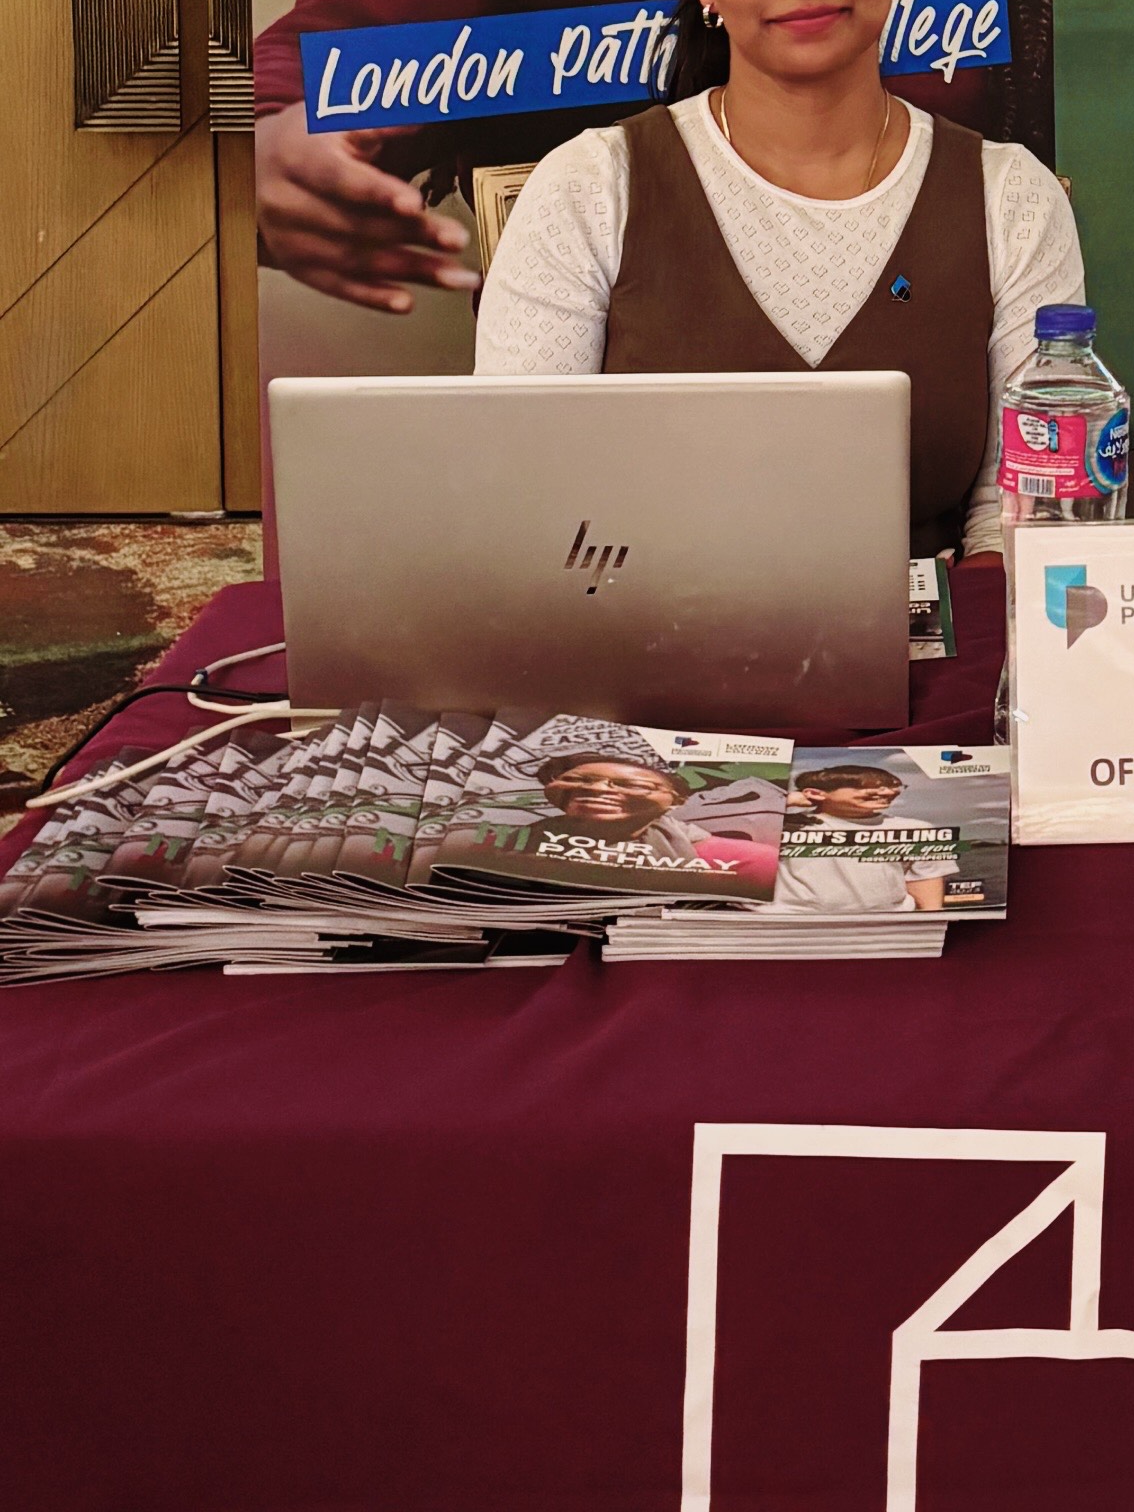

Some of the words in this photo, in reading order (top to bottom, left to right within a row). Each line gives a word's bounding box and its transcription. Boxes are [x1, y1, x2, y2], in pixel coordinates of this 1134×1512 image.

[317, 24, 525, 119] London
[1090, 757, 1134, 787] OF
[543, 830, 654, 855] YOUR
[854, 828, 953, 844] CALLING
[873, 843, 915, 856] with
[920, 843, 957, 856] you
[537, 841, 740, 871] PATHWAY
